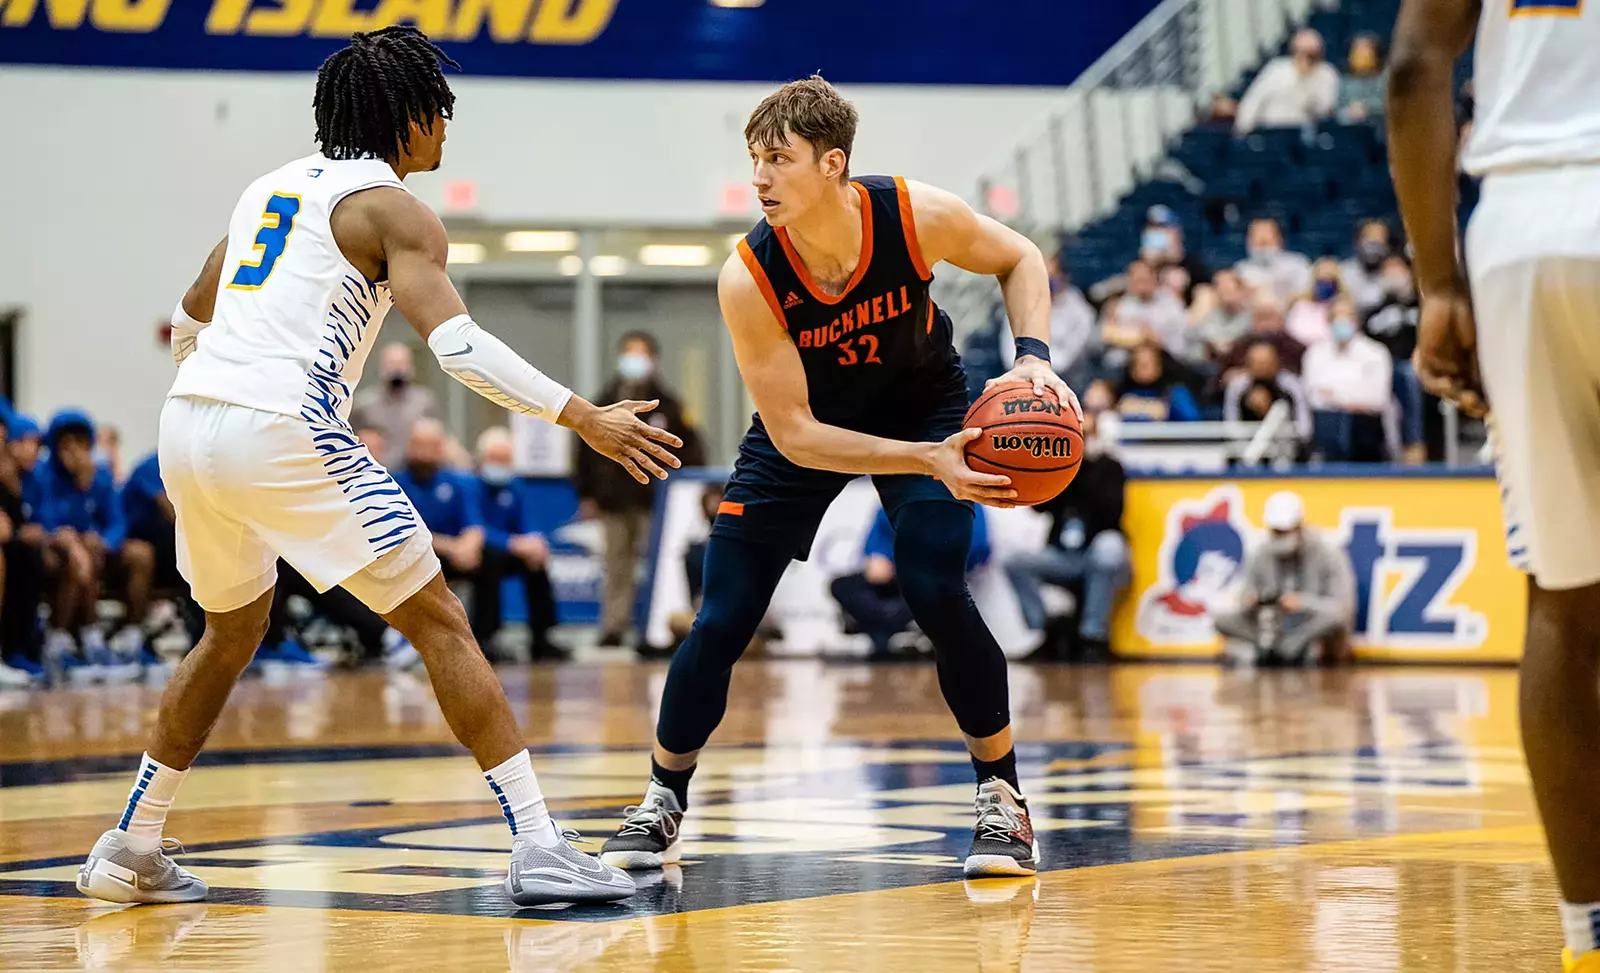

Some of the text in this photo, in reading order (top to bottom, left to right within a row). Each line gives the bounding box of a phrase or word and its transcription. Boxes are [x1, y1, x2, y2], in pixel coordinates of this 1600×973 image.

[226, 190, 302, 291] 3
[798, 285, 912, 348] BUCKNELL
[837, 334, 883, 366] 32
[1002, 398, 1063, 417] NCAA
[992, 435, 1071, 458] Wilson
[1344, 520, 1466, 635] tz
